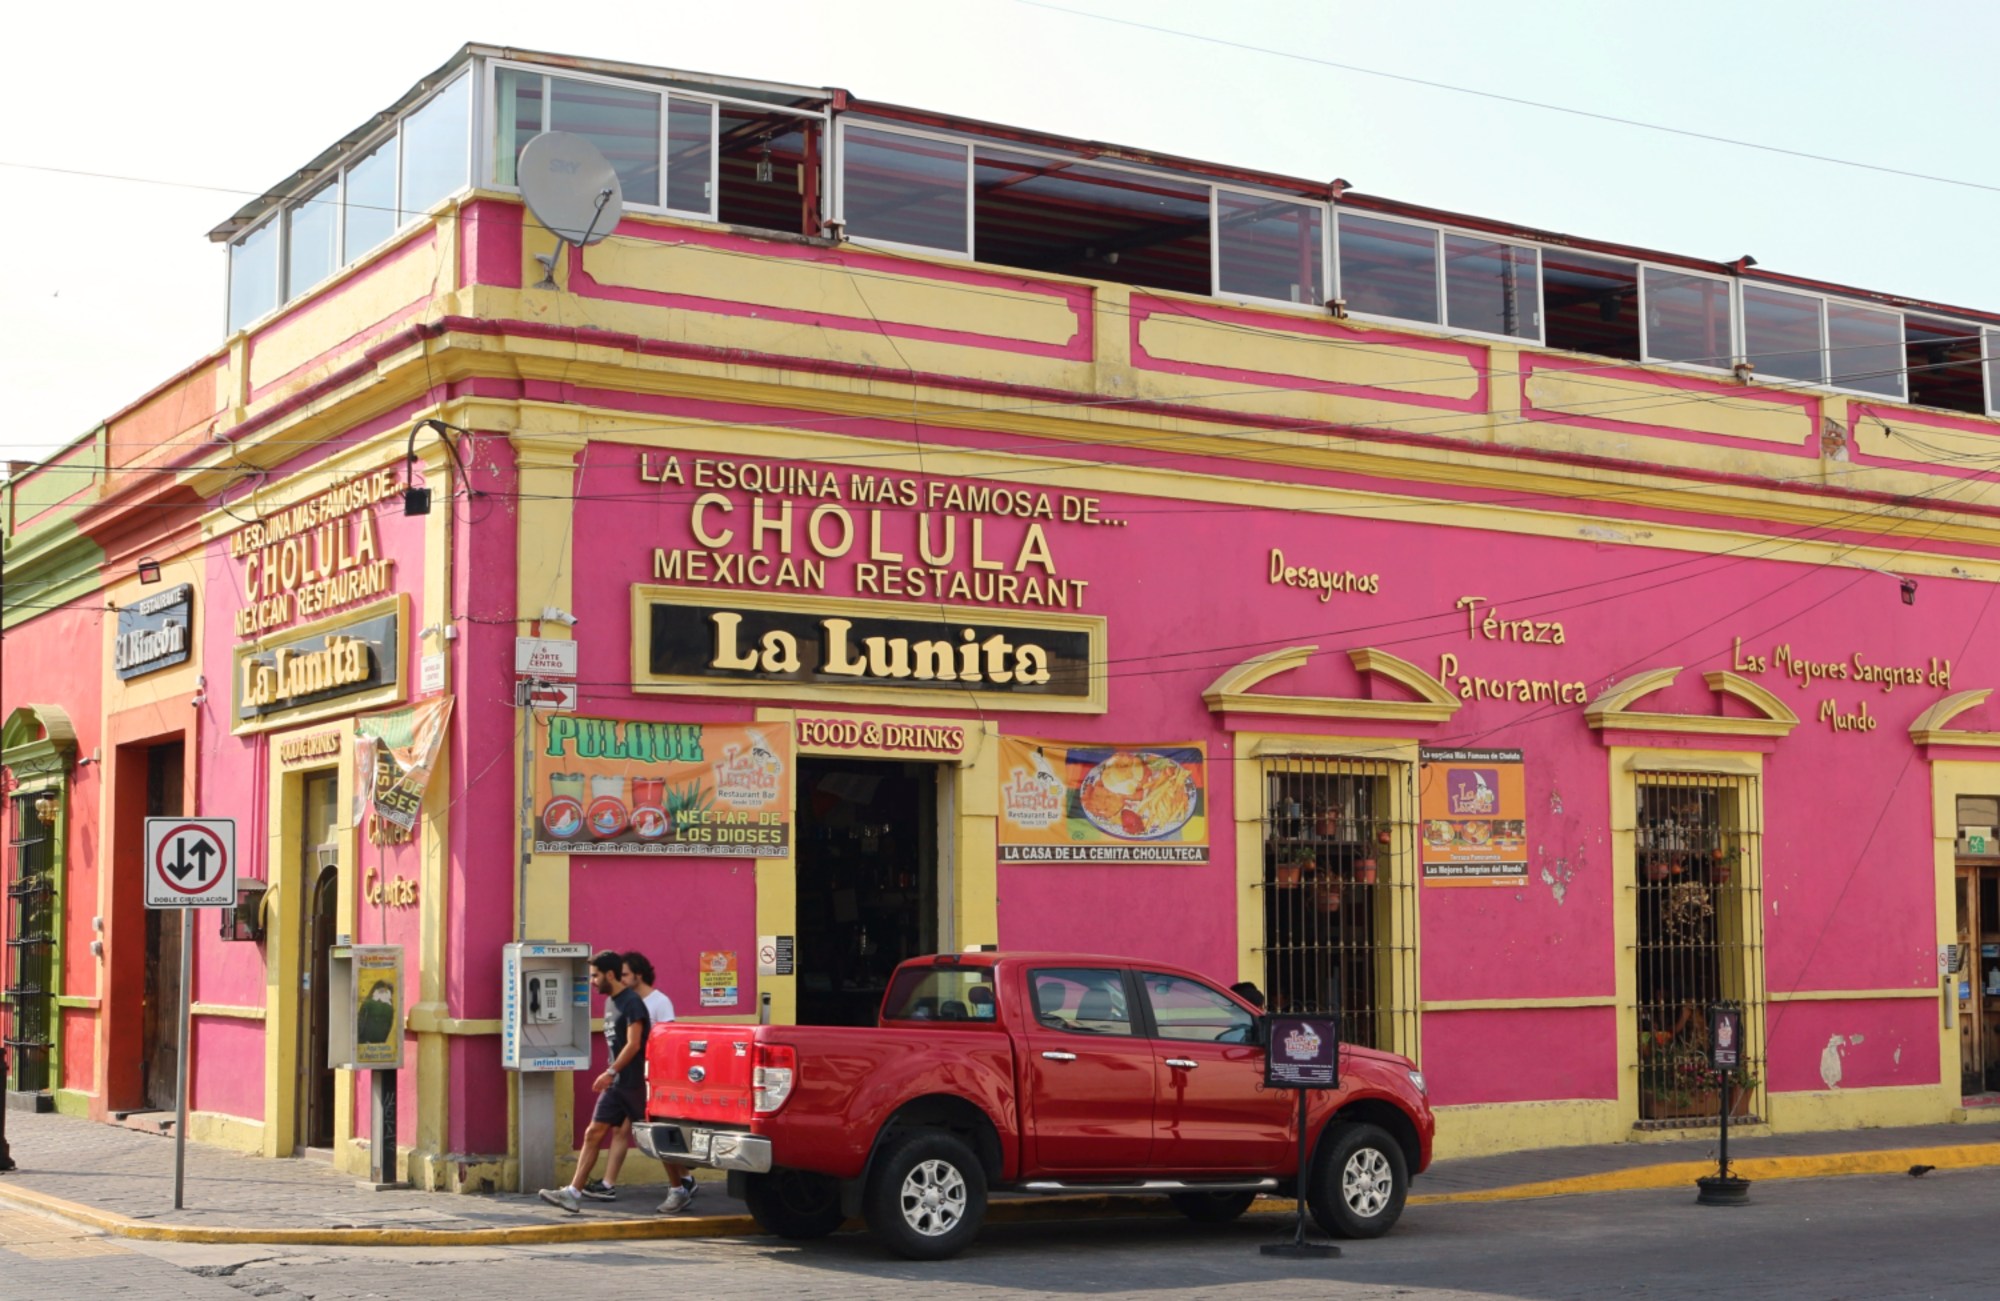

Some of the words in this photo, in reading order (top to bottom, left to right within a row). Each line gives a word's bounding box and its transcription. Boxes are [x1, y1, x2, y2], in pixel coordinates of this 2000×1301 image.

[641, 453, 685, 485] LA
[694, 459, 841, 499] ESQUINA
[851, 475, 917, 507] MAS
[928, 481, 1053, 519] FAMOSA
[230, 531, 244, 559] LA
[244, 511, 291, 551] ESQUINA
[293, 500, 317, 532] MAS
[319, 478, 370, 520] FAMOSA
[690, 492, 1057, 575] CHOLULA
[245, 509, 377, 602] CHOLULA
[653, 548, 826, 589] MEXICAN
[856, 563, 1089, 608] RESTAURANT
[1270, 548, 1379, 603] Desayunos
[235, 595, 291, 636] MEXICAN
[298, 560, 391, 615] RESTAURANT
[1456, 596, 1566, 645] Térraza
[709, 612, 800, 673] La
[820, 618, 1050, 685] Lunita
[241, 657, 275, 707] La
[275, 636, 365, 699] Lunita
[530, 660, 563, 668] CENTRO
[1733, 636, 1766, 672] Las
[1773, 643, 1847, 689] Mejores
[1928, 657, 1951, 689] del
[1818, 698, 1876, 732] Mundo
[546, 716, 704, 763] PULQUE
[801, 722, 859, 744] FOOD
[863, 726, 881, 745] &
[885, 726, 964, 750] DRINKS
[1422, 750, 1430, 758] La
[1468, 752, 1489, 760] Famosa
[1490, 752, 1498, 760] de
[1499, 752, 1520, 760] Cholula
[402, 778, 425, 798] DE
[715, 763, 775, 790] Lunita
[1014, 770, 1038, 793] La
[718, 790, 760, 799] Restaurant
[762, 791, 775, 799] Bar
[1004, 786, 1058, 811] Lunita
[1458, 783, 1475, 801] La
[676, 808, 748, 825] NÉCTAR
[758, 812, 782, 826] DE
[1008, 811, 1045, 819] Restaurant
[676, 828, 712, 842] LOS
[717, 828, 782, 843] DIOSES
[1004, 847, 1020, 859] LA
[1022, 847, 1053, 859] CASA
[1055, 848, 1070, 859] DE
[1073, 848, 1087, 859] LA
[1089, 848, 1130, 859] CEMITA
[1133, 848, 1202, 860] CHOLULTECA
[1426, 866, 1437, 874] Las
[1438, 866, 1463, 875] Mejores
[1492, 865, 1501, 873] del
[534, 1059, 576, 1067] infinitum
